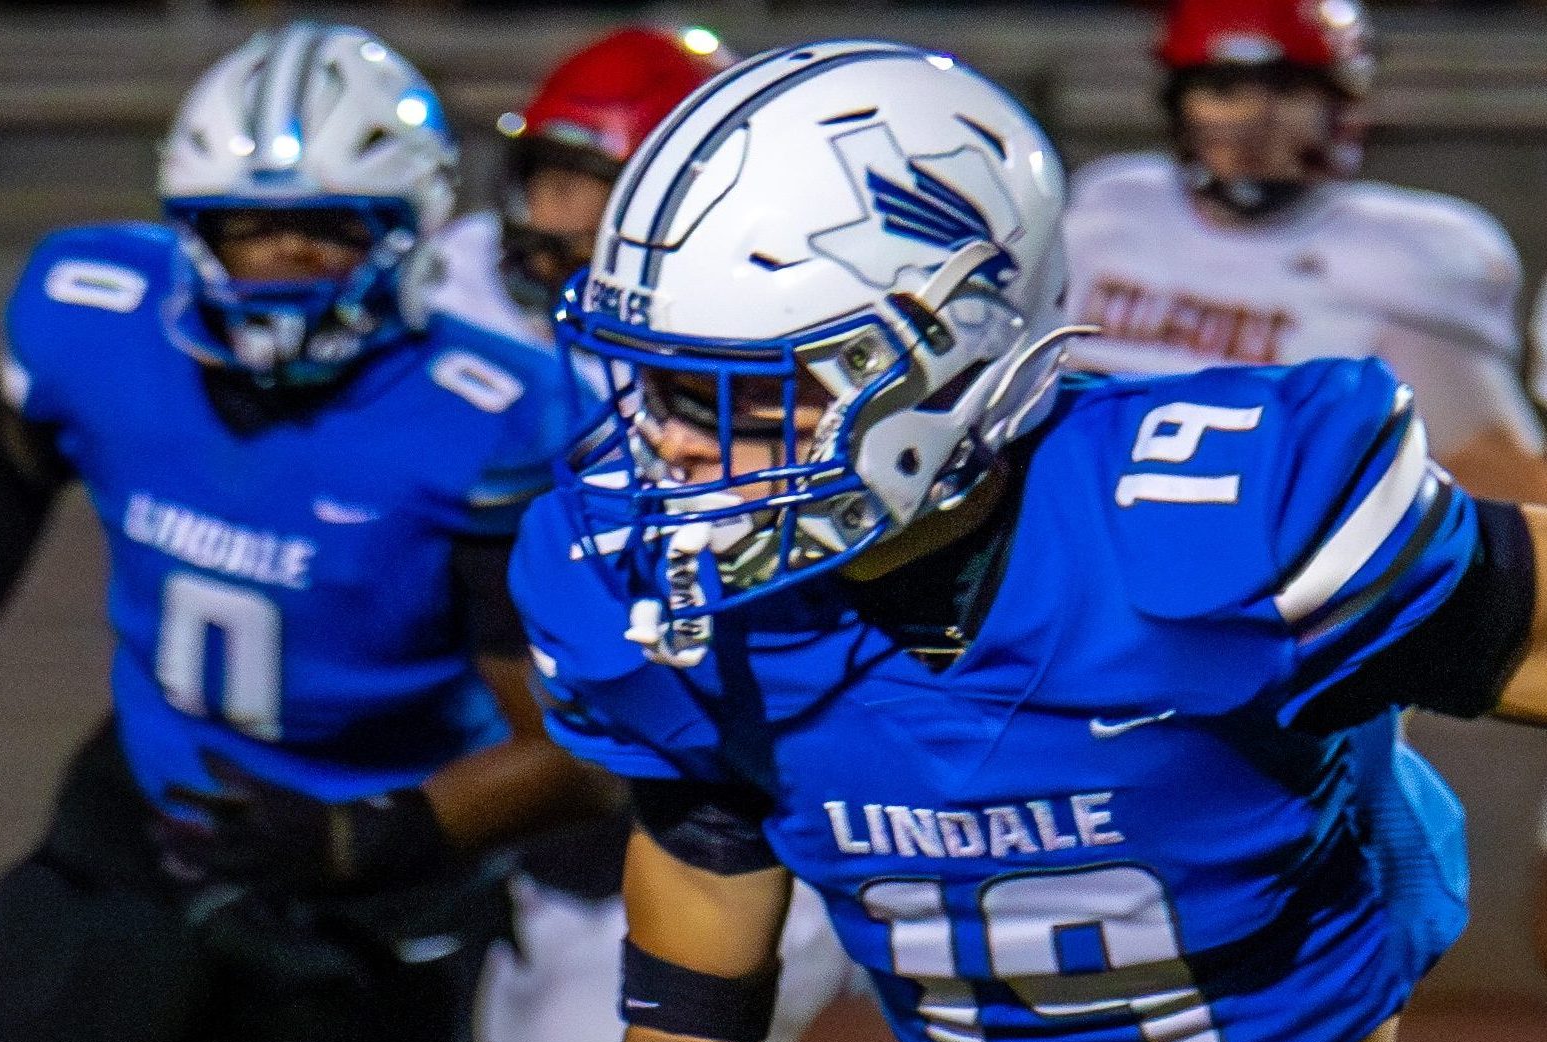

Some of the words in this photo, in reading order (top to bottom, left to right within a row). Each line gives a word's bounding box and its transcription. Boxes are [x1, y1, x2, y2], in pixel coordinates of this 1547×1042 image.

[44, 258, 148, 315] 0
[429, 347, 525, 413] 0
[1115, 401, 1264, 508] 19
[823, 792, 1126, 859] LINDALE
